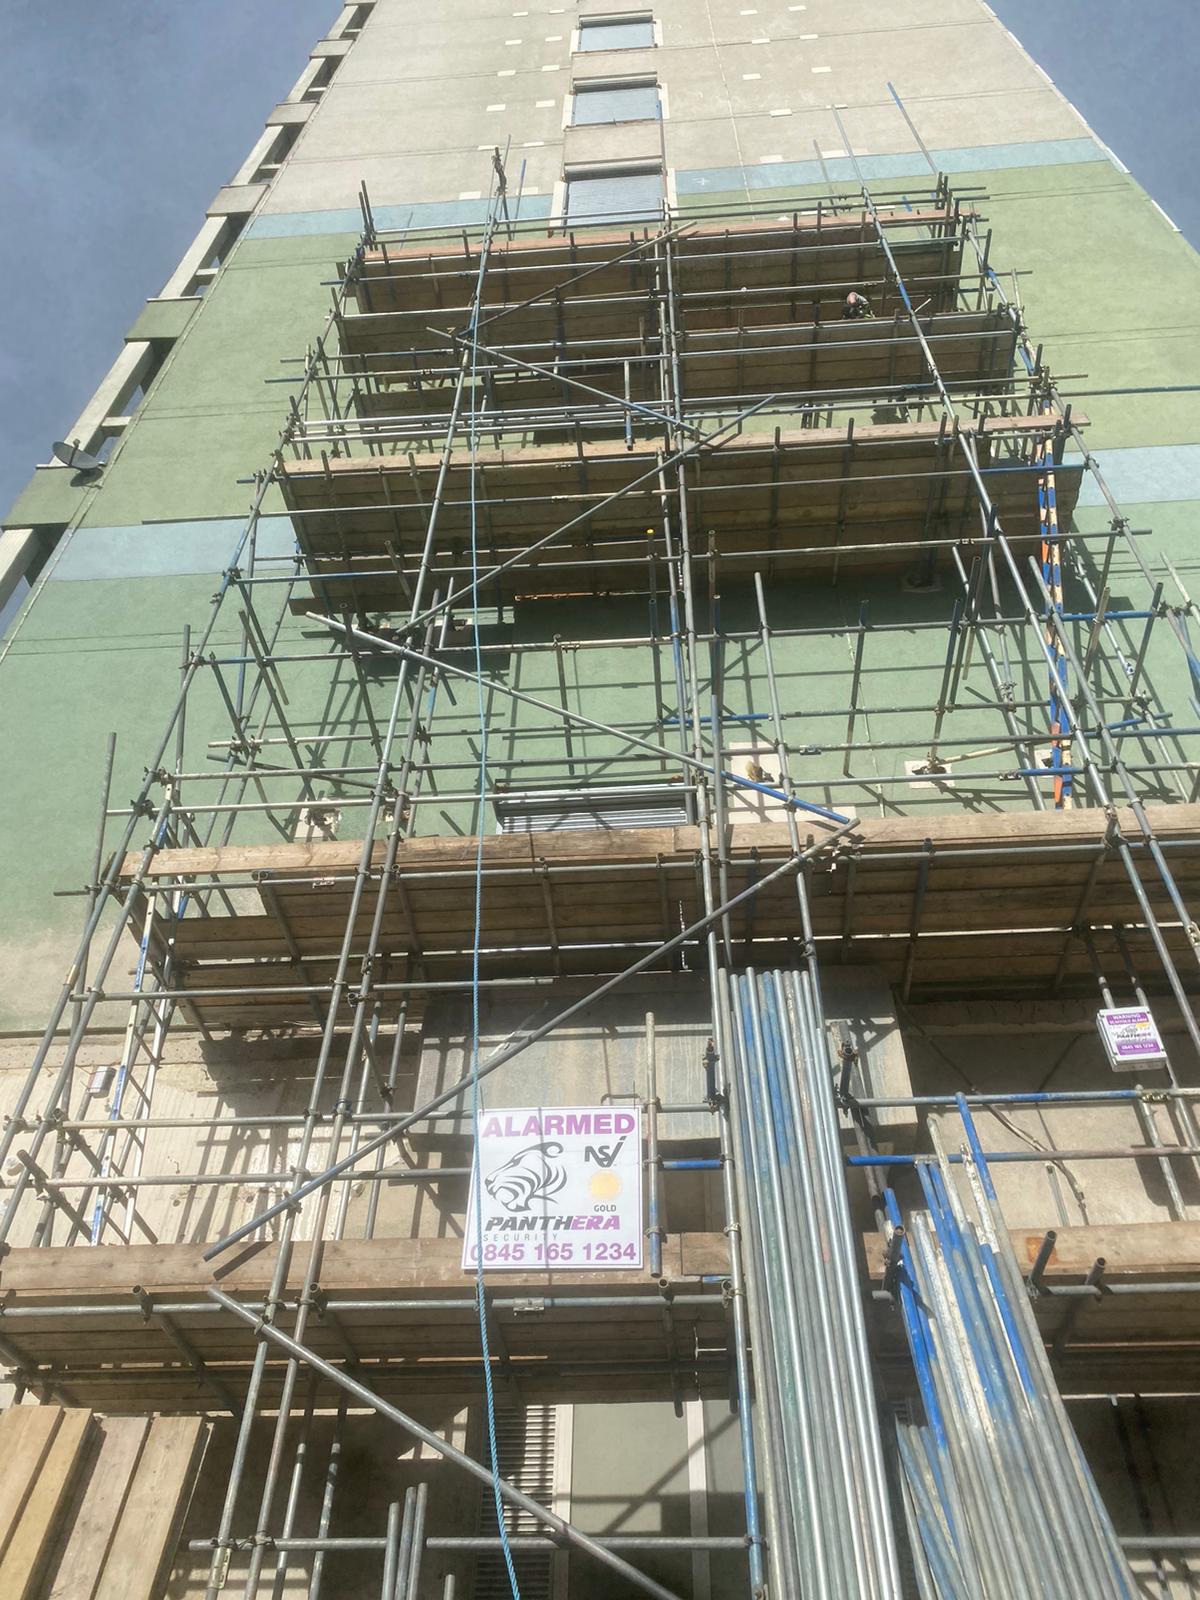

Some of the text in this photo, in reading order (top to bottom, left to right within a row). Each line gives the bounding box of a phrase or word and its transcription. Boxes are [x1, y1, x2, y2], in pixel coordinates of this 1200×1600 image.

[482, 1114, 635, 1137] ALARMED
[593, 1204, 617, 1213] GOLD
[485, 1215, 620, 1232] PANTHERA
[483, 1233, 558, 1242] SECURITY
[470, 1242, 637, 1261] 0845 165 1234
